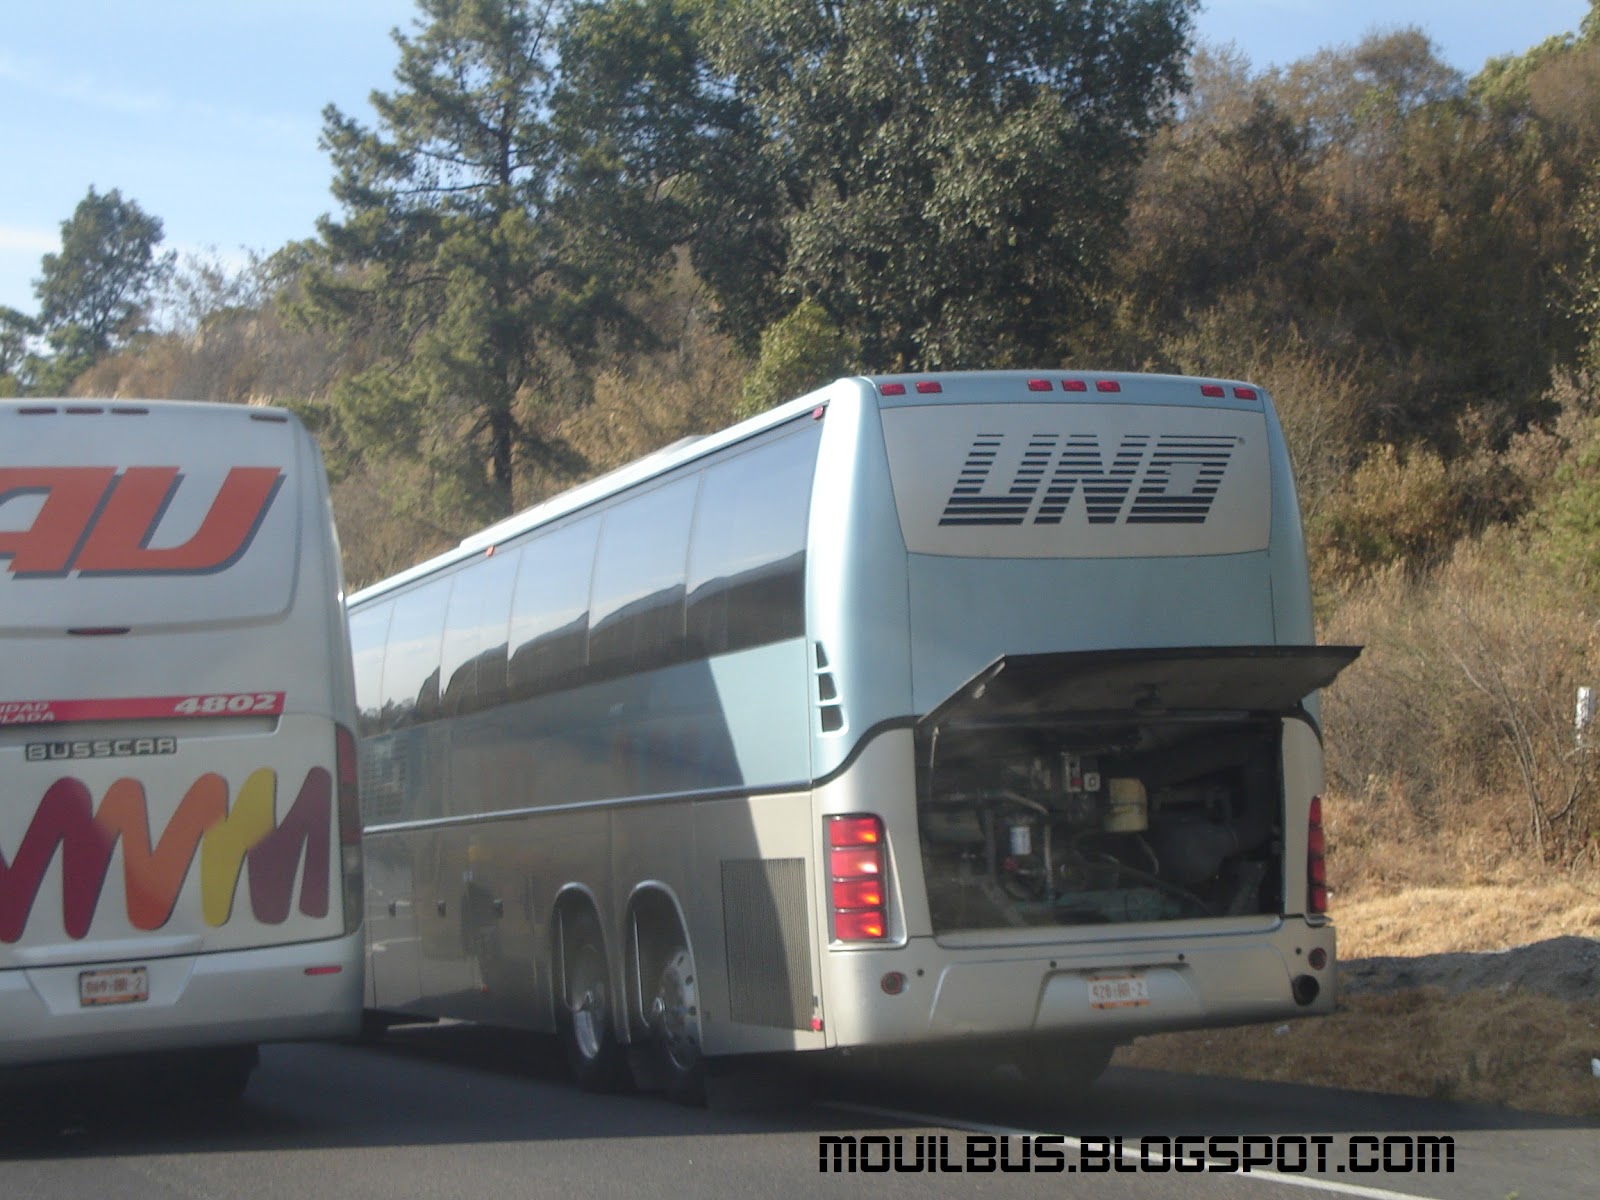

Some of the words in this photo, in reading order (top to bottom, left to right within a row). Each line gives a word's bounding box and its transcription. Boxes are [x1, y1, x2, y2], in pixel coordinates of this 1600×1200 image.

[938, 433, 1237, 526] UNO
[174, 694, 276, 714] 4802
[26, 738, 177, 761] BUSSCAR
